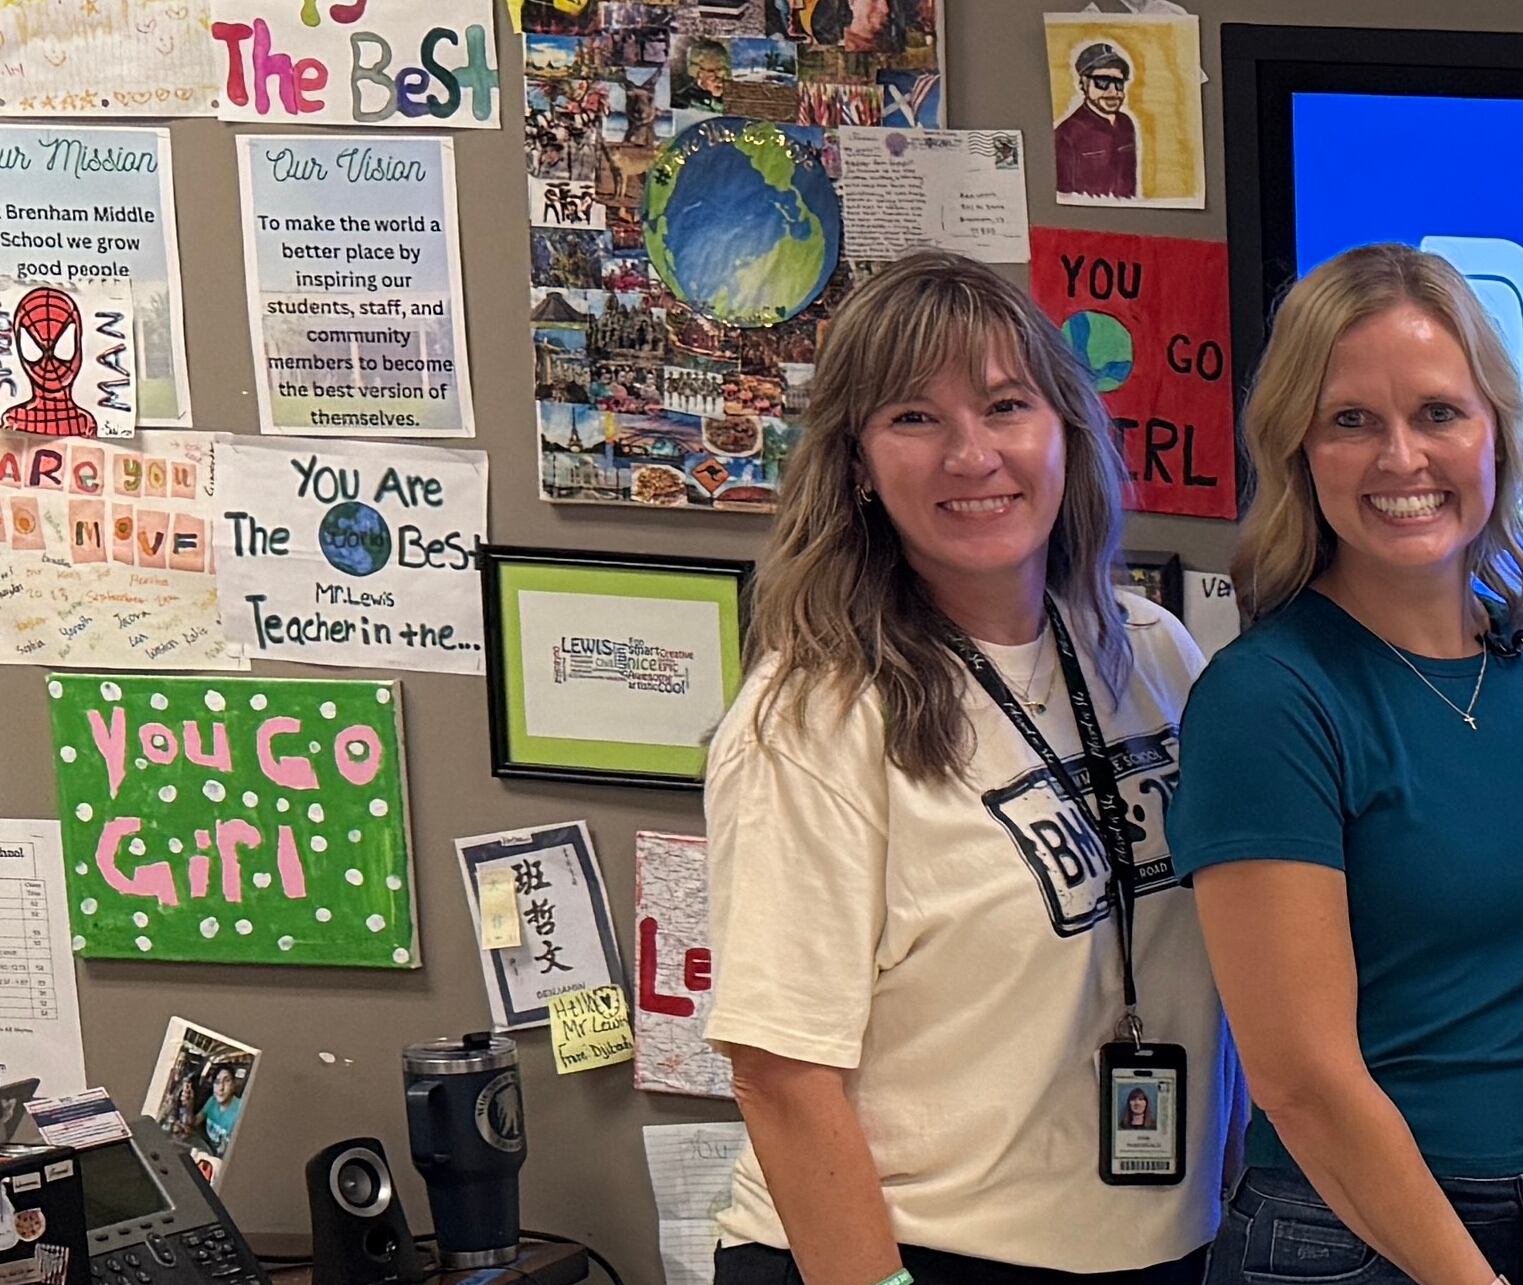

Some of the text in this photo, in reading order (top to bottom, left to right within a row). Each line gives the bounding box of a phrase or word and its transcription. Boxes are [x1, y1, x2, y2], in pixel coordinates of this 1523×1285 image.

[212, 18, 328, 115] The
[38, 137, 159, 179] Mission
[266, 147, 427, 183] Our Vision
[6, 204, 156, 224] Brenham Middle
[258, 214, 443, 234] To make the world a
[1, 231, 141, 256] School we grow
[281, 242, 421, 265] better place by
[17, 260, 130, 285] good people
[296, 271, 413, 293] inspiring our
[1061, 254, 1142, 300] YOU
[266, 298, 444, 319] students, staff, and
[307, 328, 411, 349] community
[268, 353, 454, 373] members to become
[1166, 333, 1224, 382] GO
[278, 380, 449, 402] the best version of
[311, 407, 420, 428] themselves.
[1111, 417, 1218, 486] IRL
[373, 466, 444, 509] Are
[224, 511, 291, 558] The
[246, 594, 357, 652] Teacher
[360, 616, 398, 645] in
[561, 636, 614, 657] LEWIS
[1138, 861, 1168, 879] ROAD
